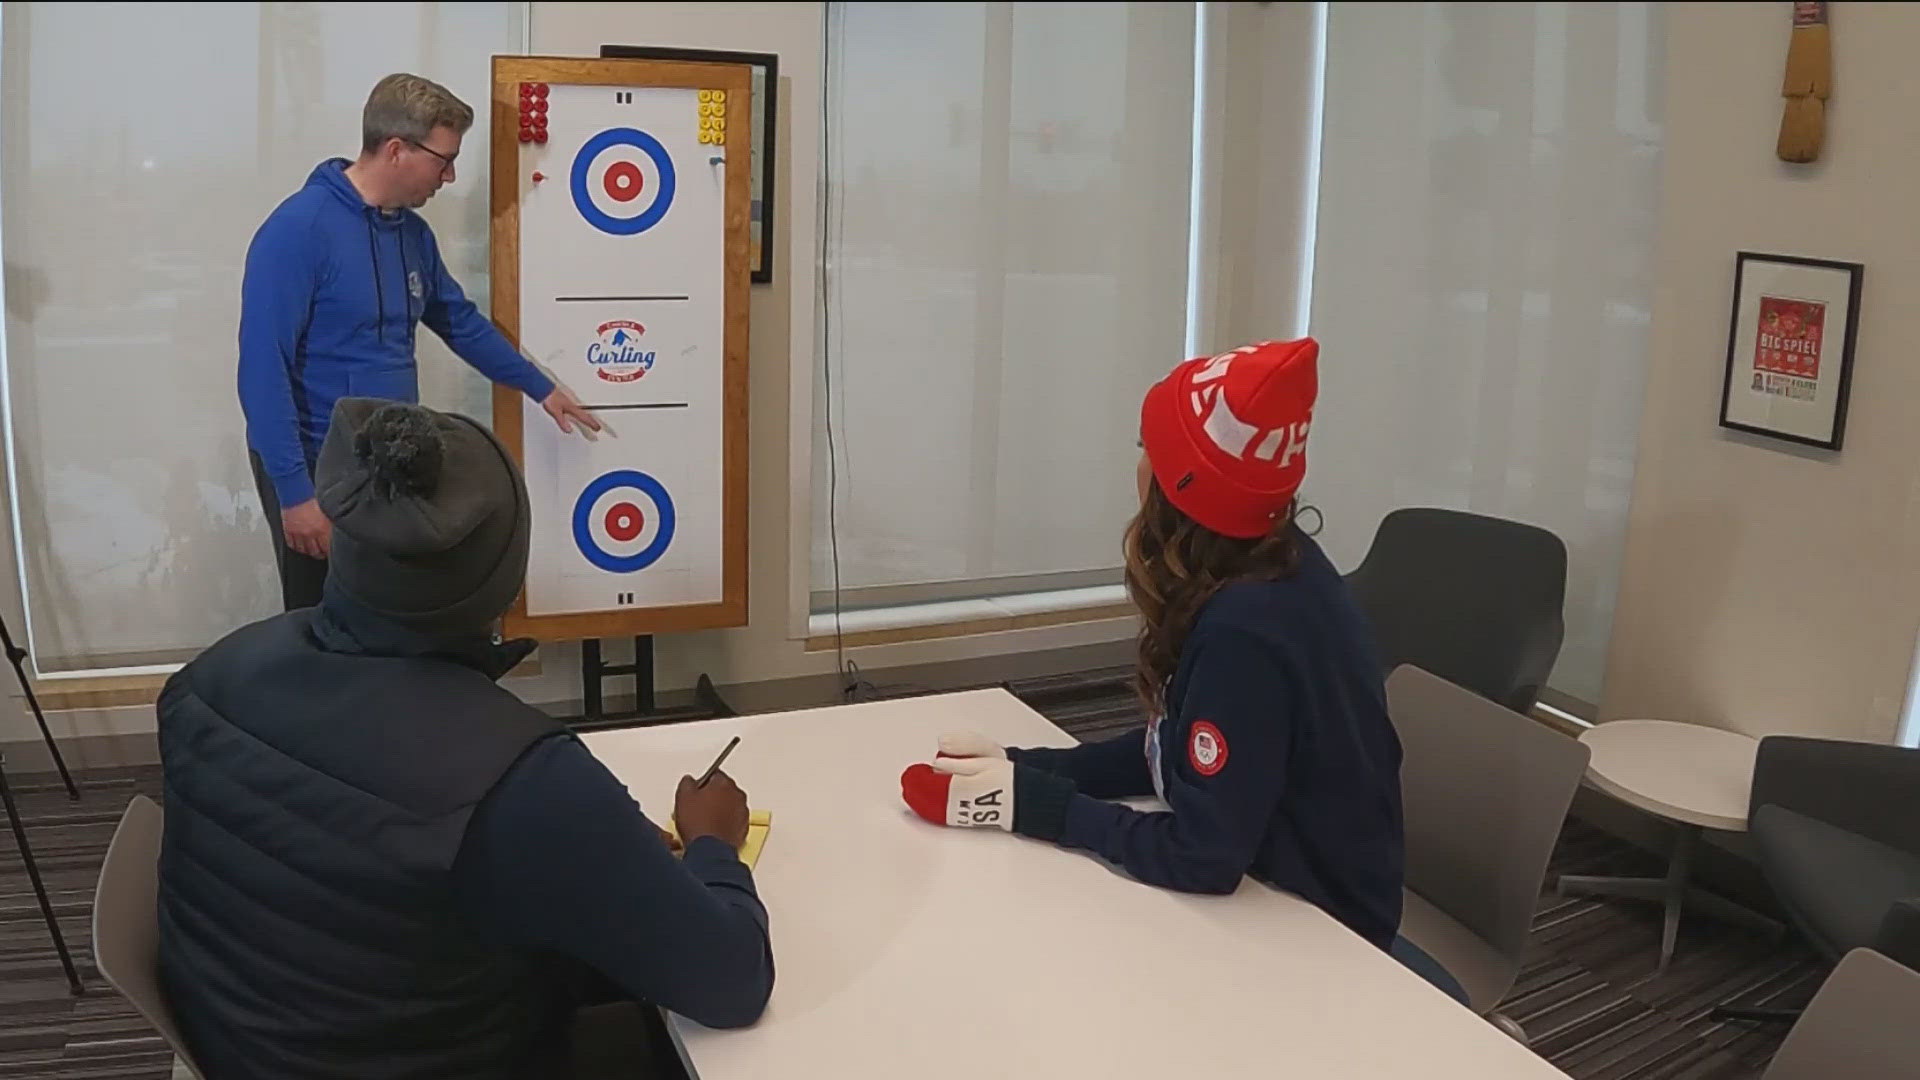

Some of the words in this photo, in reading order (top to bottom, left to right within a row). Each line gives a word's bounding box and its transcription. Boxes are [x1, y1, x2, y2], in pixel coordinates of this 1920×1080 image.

[587, 342, 656, 370] Curling
[1760, 333, 1781, 350] BIG
[1783, 339, 1817, 355] SPIEL
[972, 789, 1004, 826] SA
